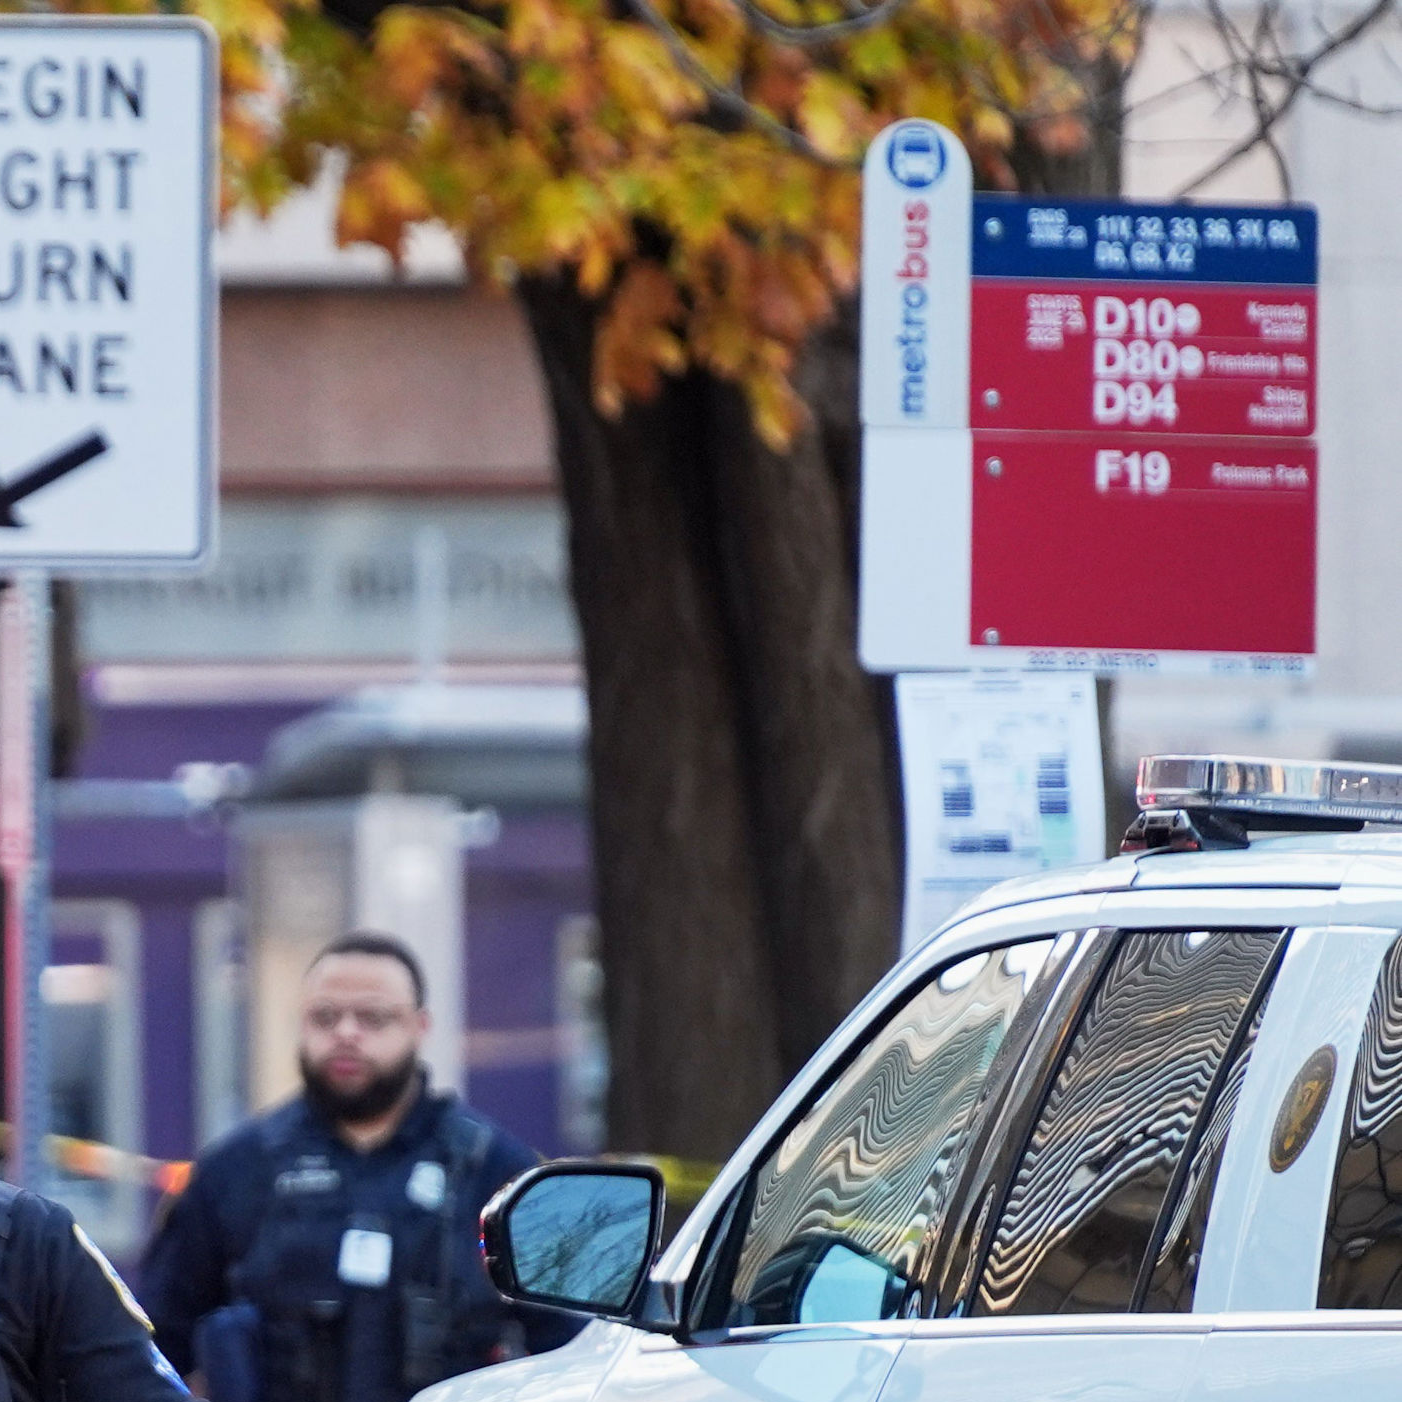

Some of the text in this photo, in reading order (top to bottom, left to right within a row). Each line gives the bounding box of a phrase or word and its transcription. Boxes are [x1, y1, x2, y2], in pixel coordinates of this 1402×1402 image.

[896, 200, 929, 417] metrobus
[1095, 296, 1177, 340] D10
[1094, 338, 1179, 381] D80
[1094, 380, 1179, 425] D94
[1095, 450, 1172, 495] F19
